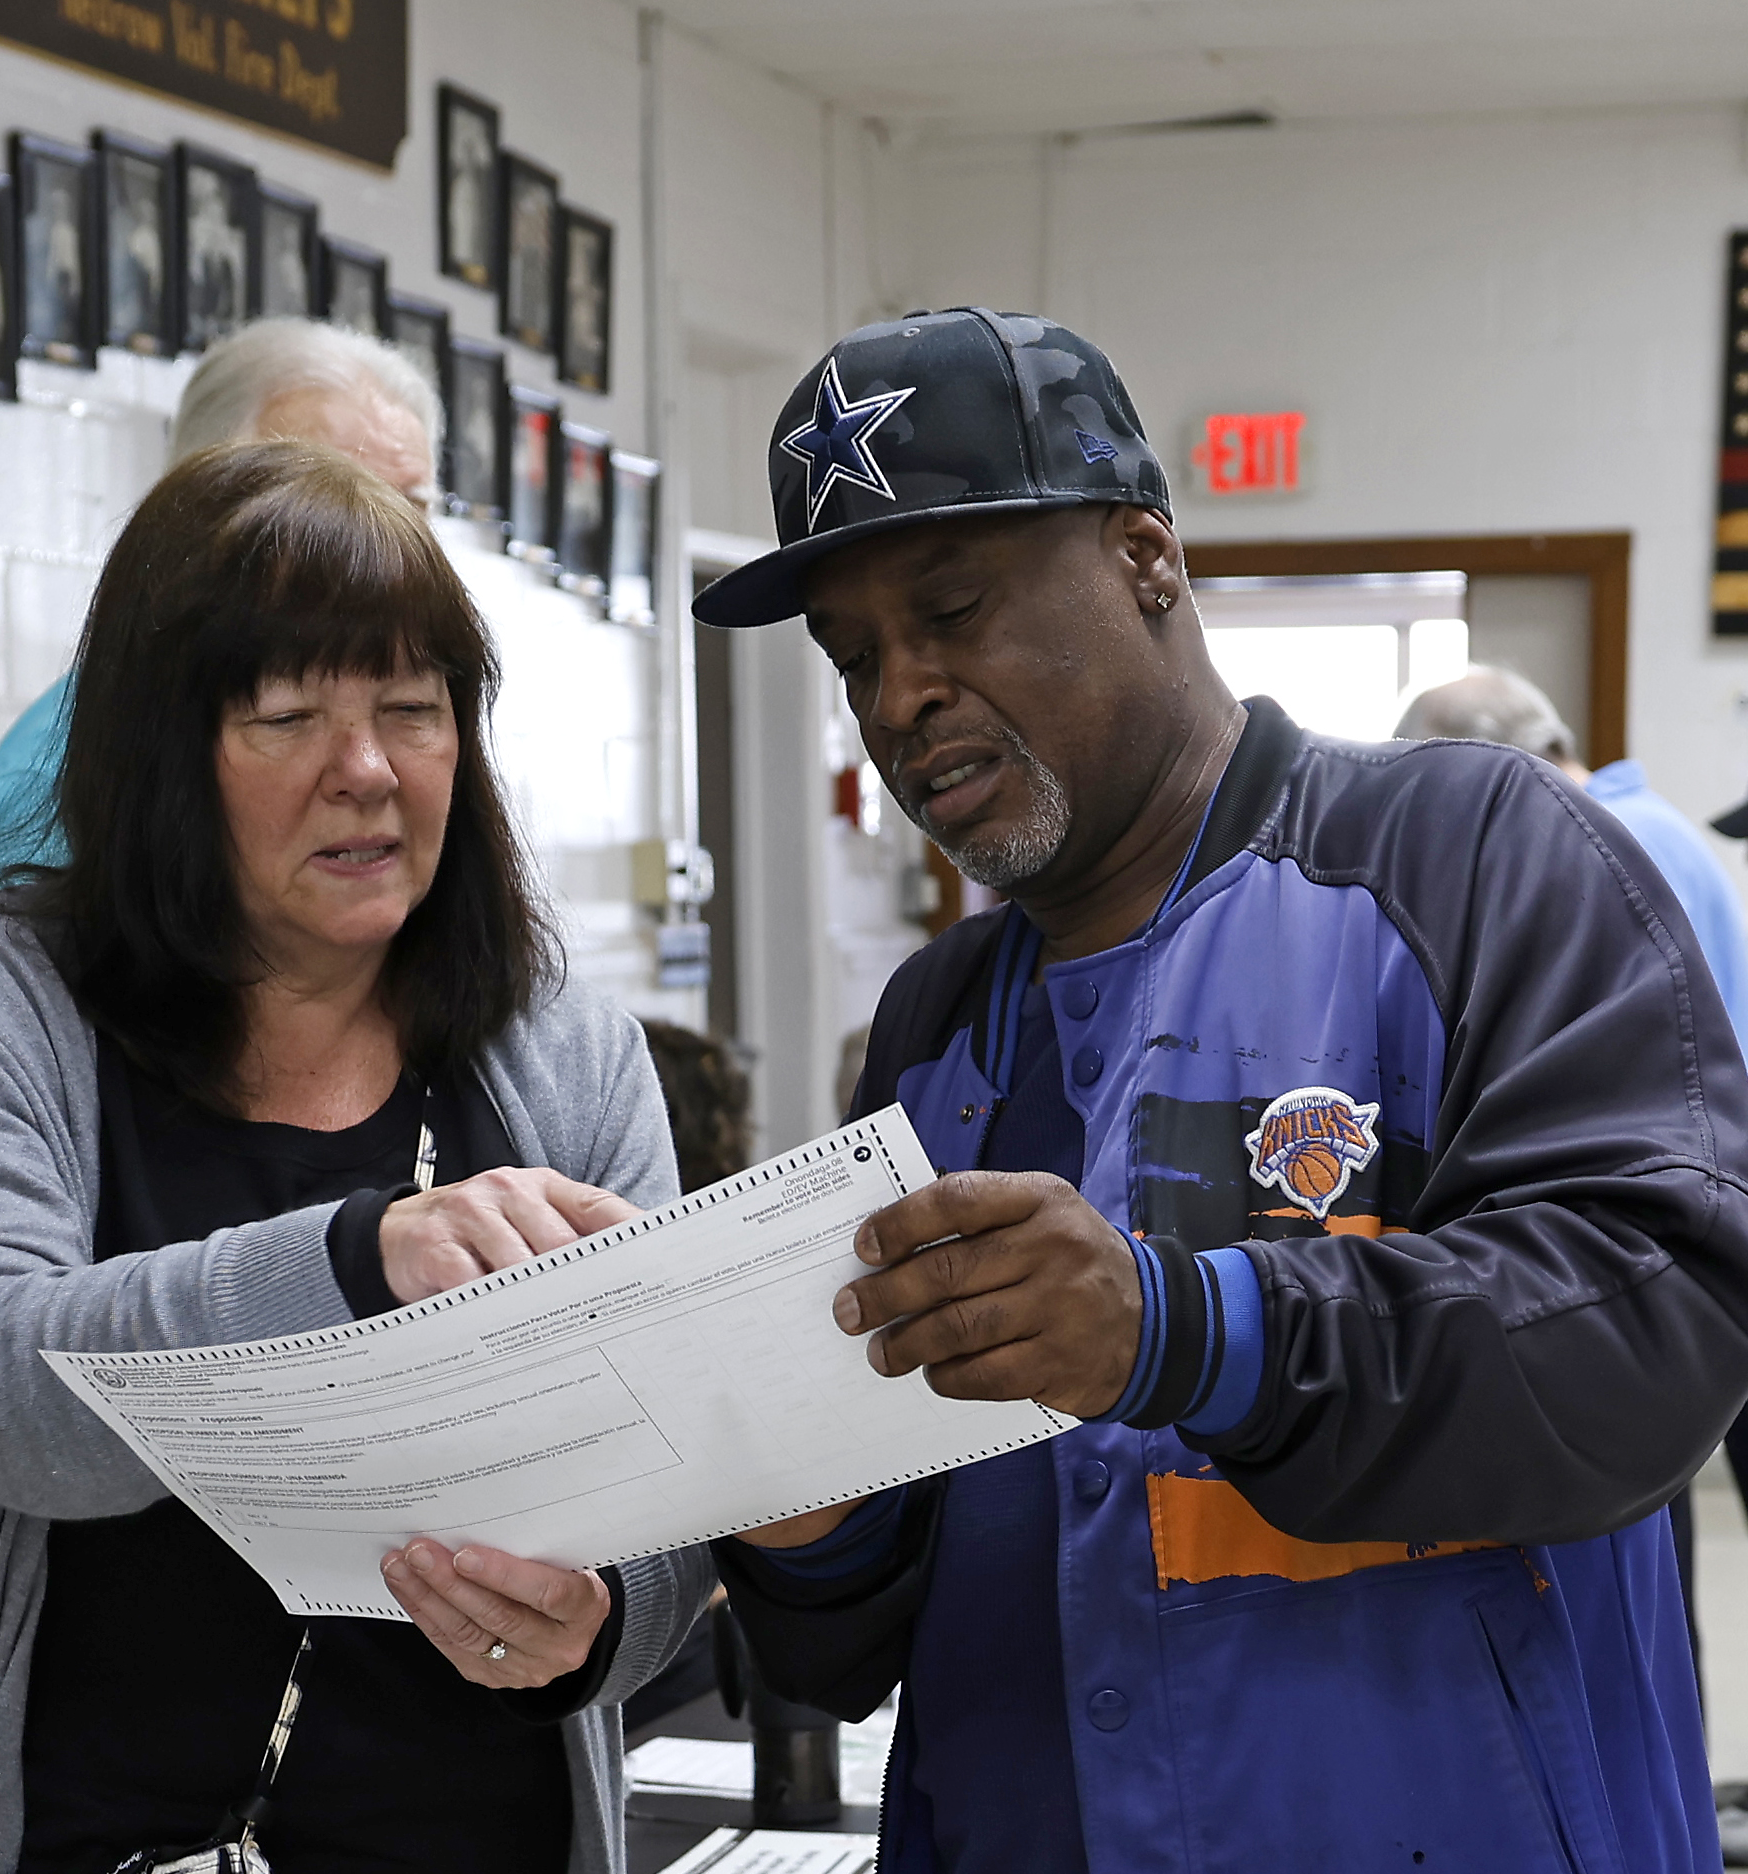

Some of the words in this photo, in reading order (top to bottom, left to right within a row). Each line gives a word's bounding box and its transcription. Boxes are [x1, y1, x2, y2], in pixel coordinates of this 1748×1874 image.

[1207, 412, 1307, 492] EXIT
[1279, 1099, 1301, 1117] NEW
[1300, 1096, 1328, 1110] YORK
[1257, 1103, 1370, 1169] KNICKS
[780, 1181, 809, 1199] ED/EV
[808, 1164, 847, 1187] Machine
[783, 1161, 831, 1188] Onondaga
[830, 1156, 843, 1167] 08
[742, 1200, 784, 1223] Remember
[784, 1197, 794, 1205] to
[794, 1189, 812, 1201] vote
[812, 1181, 830, 1193] both
[831, 1172, 851, 1185] sides
[757, 1210, 781, 1225] Boleta
[781, 1197, 810, 1215] electoral
[810, 1193, 820, 1202] de
[820, 1187, 834, 1198] dos
[834, 1179, 854, 1192] lados
[736, 1259, 751, 1271] pida
[751, 1254, 765, 1264] una
[765, 1246, 785, 1259] nueva
[785, 1237, 806, 1251] boleta
[812, 1232, 822, 1240] un
[821, 1217, 855, 1237] empleado
[478, 1318, 529, 1341] Instrucciones
[530, 1313, 547, 1324] Para
[547, 1305, 568, 1318] Votar
[568, 1301, 582, 1310] Por
[588, 1293, 604, 1303] una
[604, 1279, 642, 1298] Propuesta
[485, 1339, 500, 1349] Para
[516, 1391, 537, 1402] sexual
[576, 1370, 602, 1384] gender
[199, 1415, 263, 1423] Proposiciones
[253, 1427, 305, 1435] AMENDMENT
